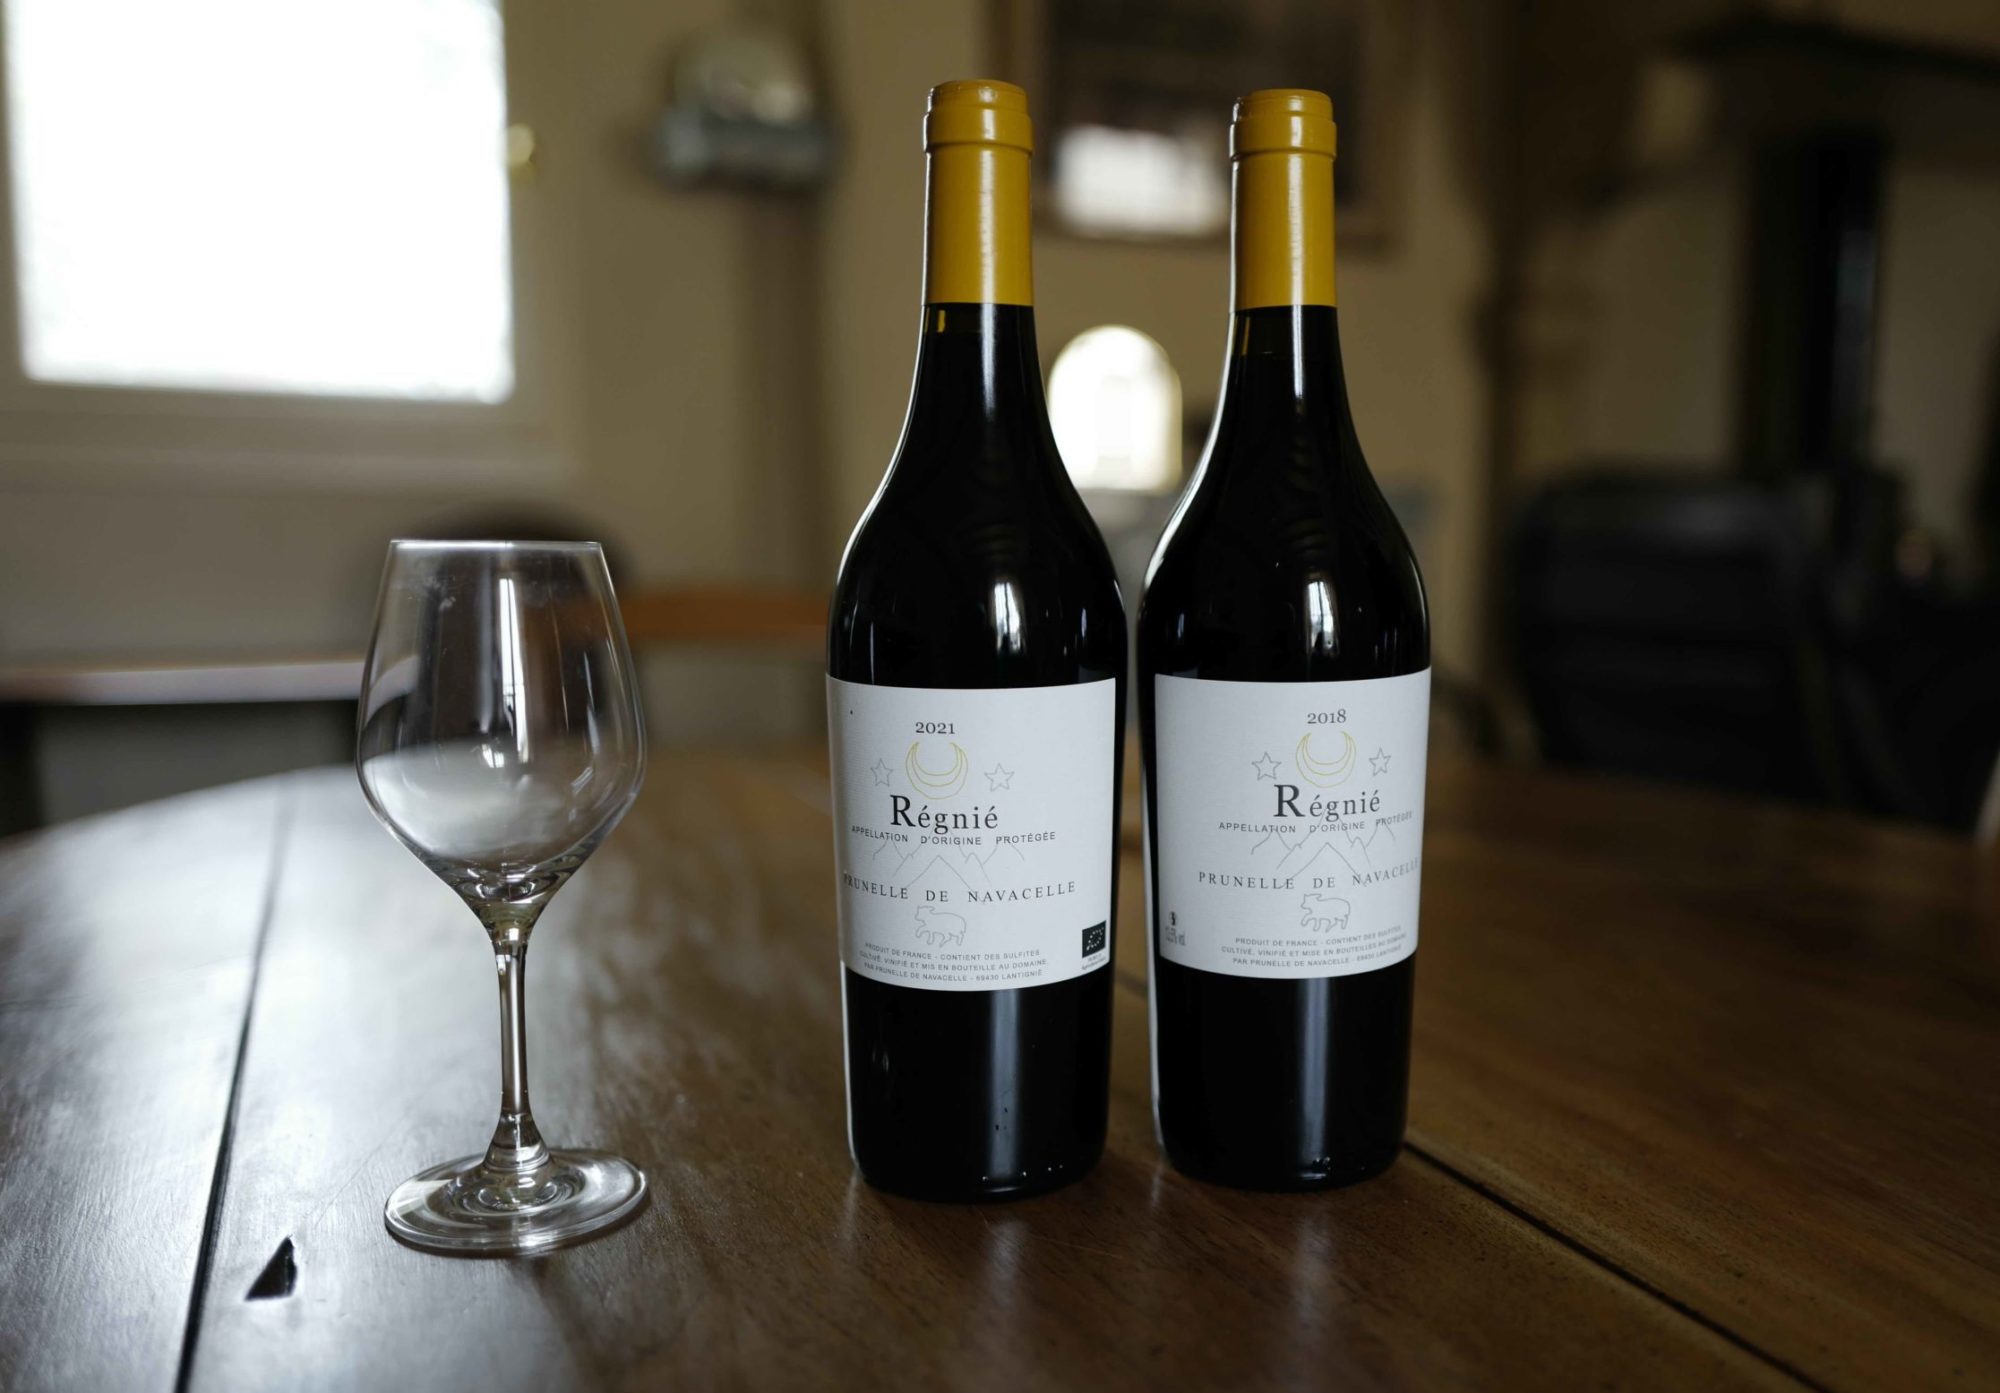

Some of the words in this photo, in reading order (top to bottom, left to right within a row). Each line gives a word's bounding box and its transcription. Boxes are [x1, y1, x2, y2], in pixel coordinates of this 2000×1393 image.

[1307, 709, 1347, 724] 2018
[915, 721, 955, 735] 2021
[1273, 784, 1380, 822] Régnié
[890, 794, 998, 835] Régnié
[851, 825, 908, 843] APPELLATION
[921, 836, 982, 846] D'ORIGINE
[996, 831, 1056, 845] PROTÉGÉE
[1219, 822, 1296, 833] APPELLATION
[1309, 821, 1365, 833] D'ORIGINE
[843, 873, 909, 899] PRUNELLE
[926, 890, 949, 902] DE
[968, 881, 1076, 903] NAVACELLE
[1199, 871, 1294, 889] PRUNELLE
[1313, 877, 1336, 888] DE
[1235, 937, 1269, 946] PRODUIT
[1326, 935, 1361, 945] CONTIENT
[865, 942, 890, 954] PRODUIT
[902, 950, 932, 960] FRANCE
[940, 953, 980, 961] CONTIENT
[984, 953, 1000, 961] DES
[1004, 949, 1040, 959] SULFITES
[864, 962, 874, 970] PAR
[875, 965, 908, 977] PRUNELLE
[1002, 969, 1042, 980] LANTIGNIÉ
[1012, 959, 1047, 969] DOMAINE
[1233, 957, 1248, 965] PAR
[1250, 959, 1291, 967] PRUNELLE
[1307, 958, 1349, 967] NAVACELLE
